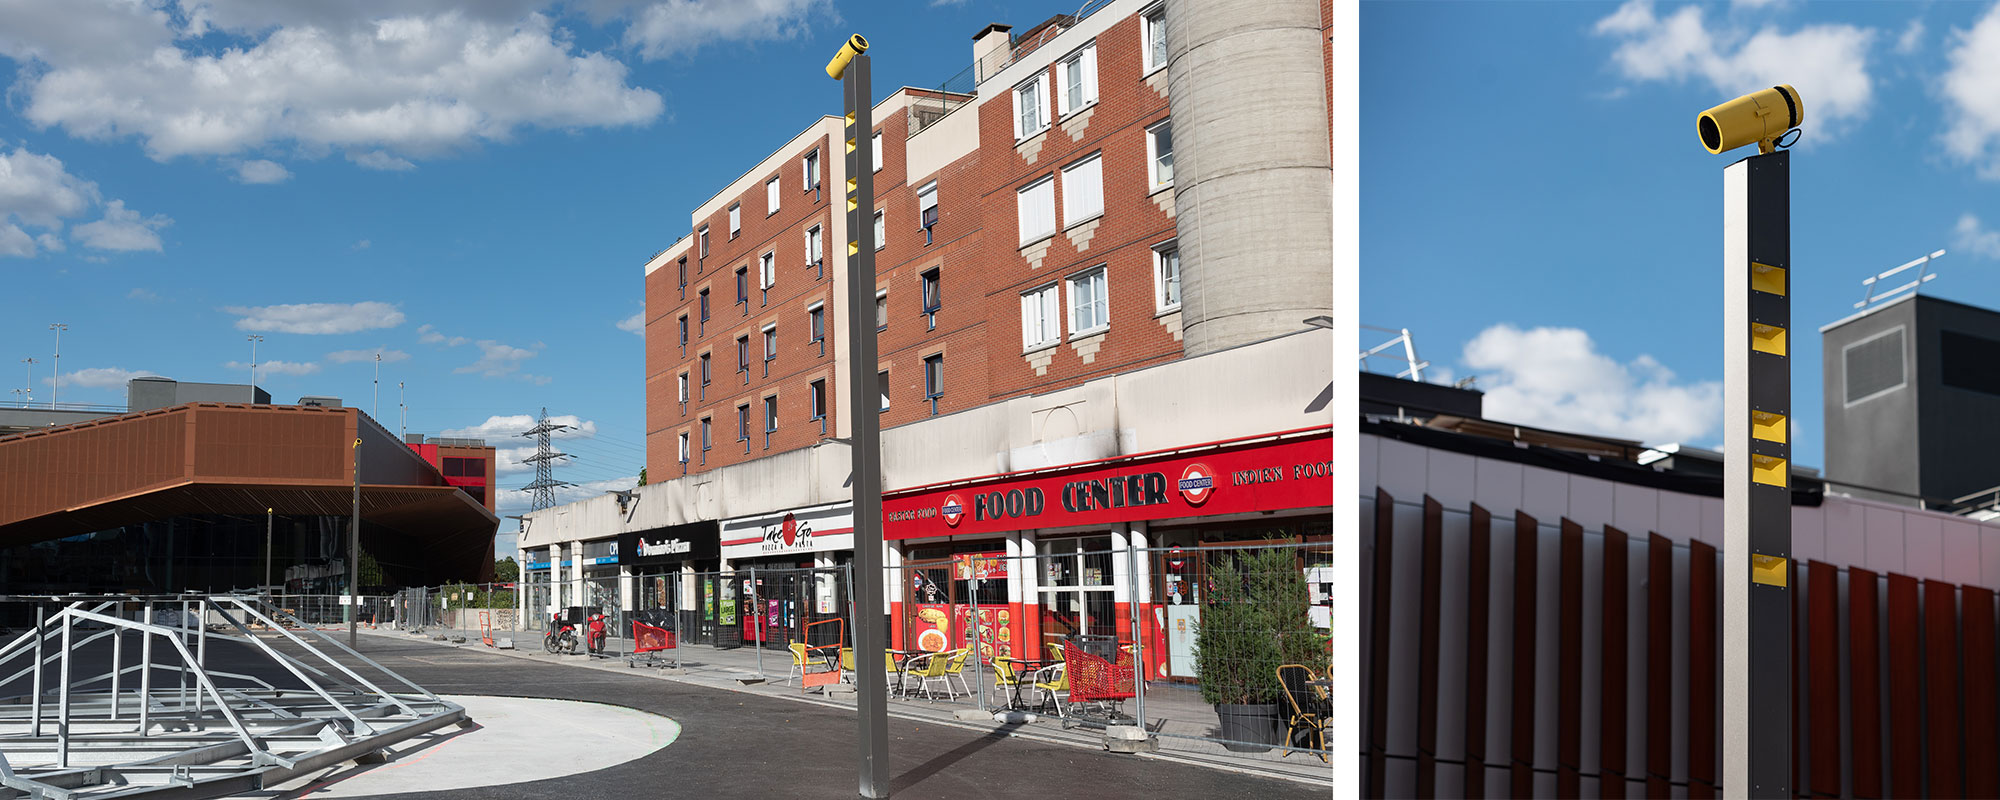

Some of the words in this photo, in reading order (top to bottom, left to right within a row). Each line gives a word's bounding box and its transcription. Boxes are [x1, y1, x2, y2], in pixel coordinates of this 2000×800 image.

[1179, 480, 1192, 488] FOOD
[1193, 478, 1211, 488] CENTER
[1232, 466, 1284, 486] INDIEN
[974, 487, 1045, 521] FOOD
[1061, 472, 1169, 513] CENTER
[917, 507, 937, 519] FOOD
[761, 525, 784, 544] Take
[795, 521, 812, 545] Go
